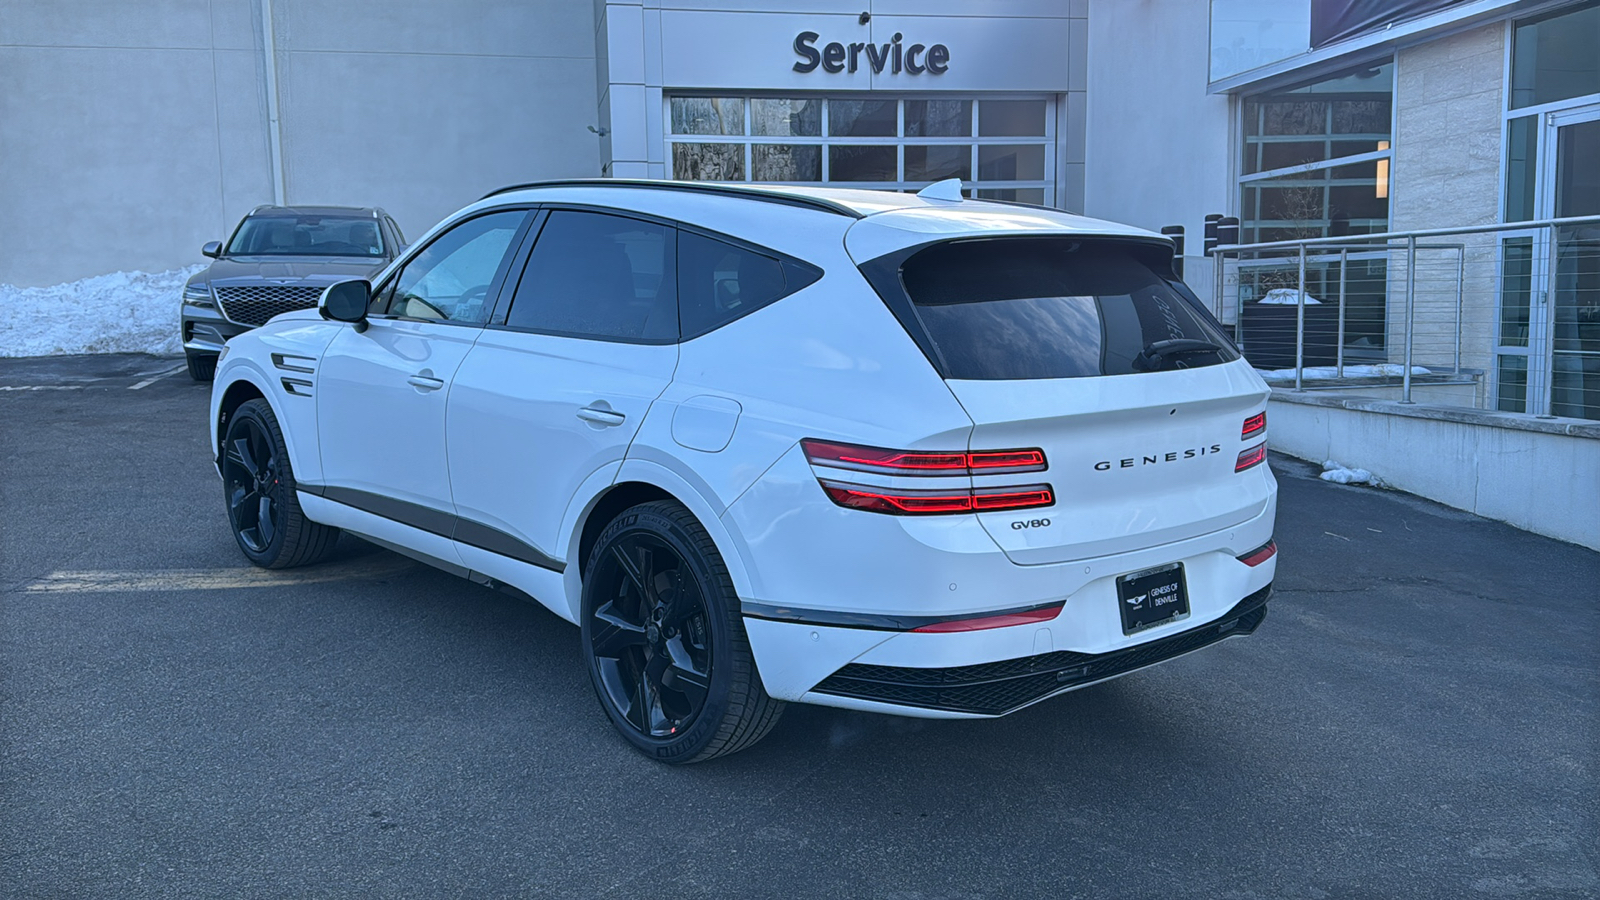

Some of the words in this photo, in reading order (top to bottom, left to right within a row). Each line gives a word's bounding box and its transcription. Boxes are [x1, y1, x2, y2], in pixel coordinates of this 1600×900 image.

[793, 31, 950, 75] Service
[1094, 444, 1221, 471] GENESIS
[1010, 518, 1051, 530] GV80
[594, 515, 637, 556] MICHELIN
[1150, 584, 1170, 596] GENESIS
[1170, 582, 1178, 591] OF
[1154, 593, 1178, 607] DENVILLE
[694, 616, 704, 635] ESIS
